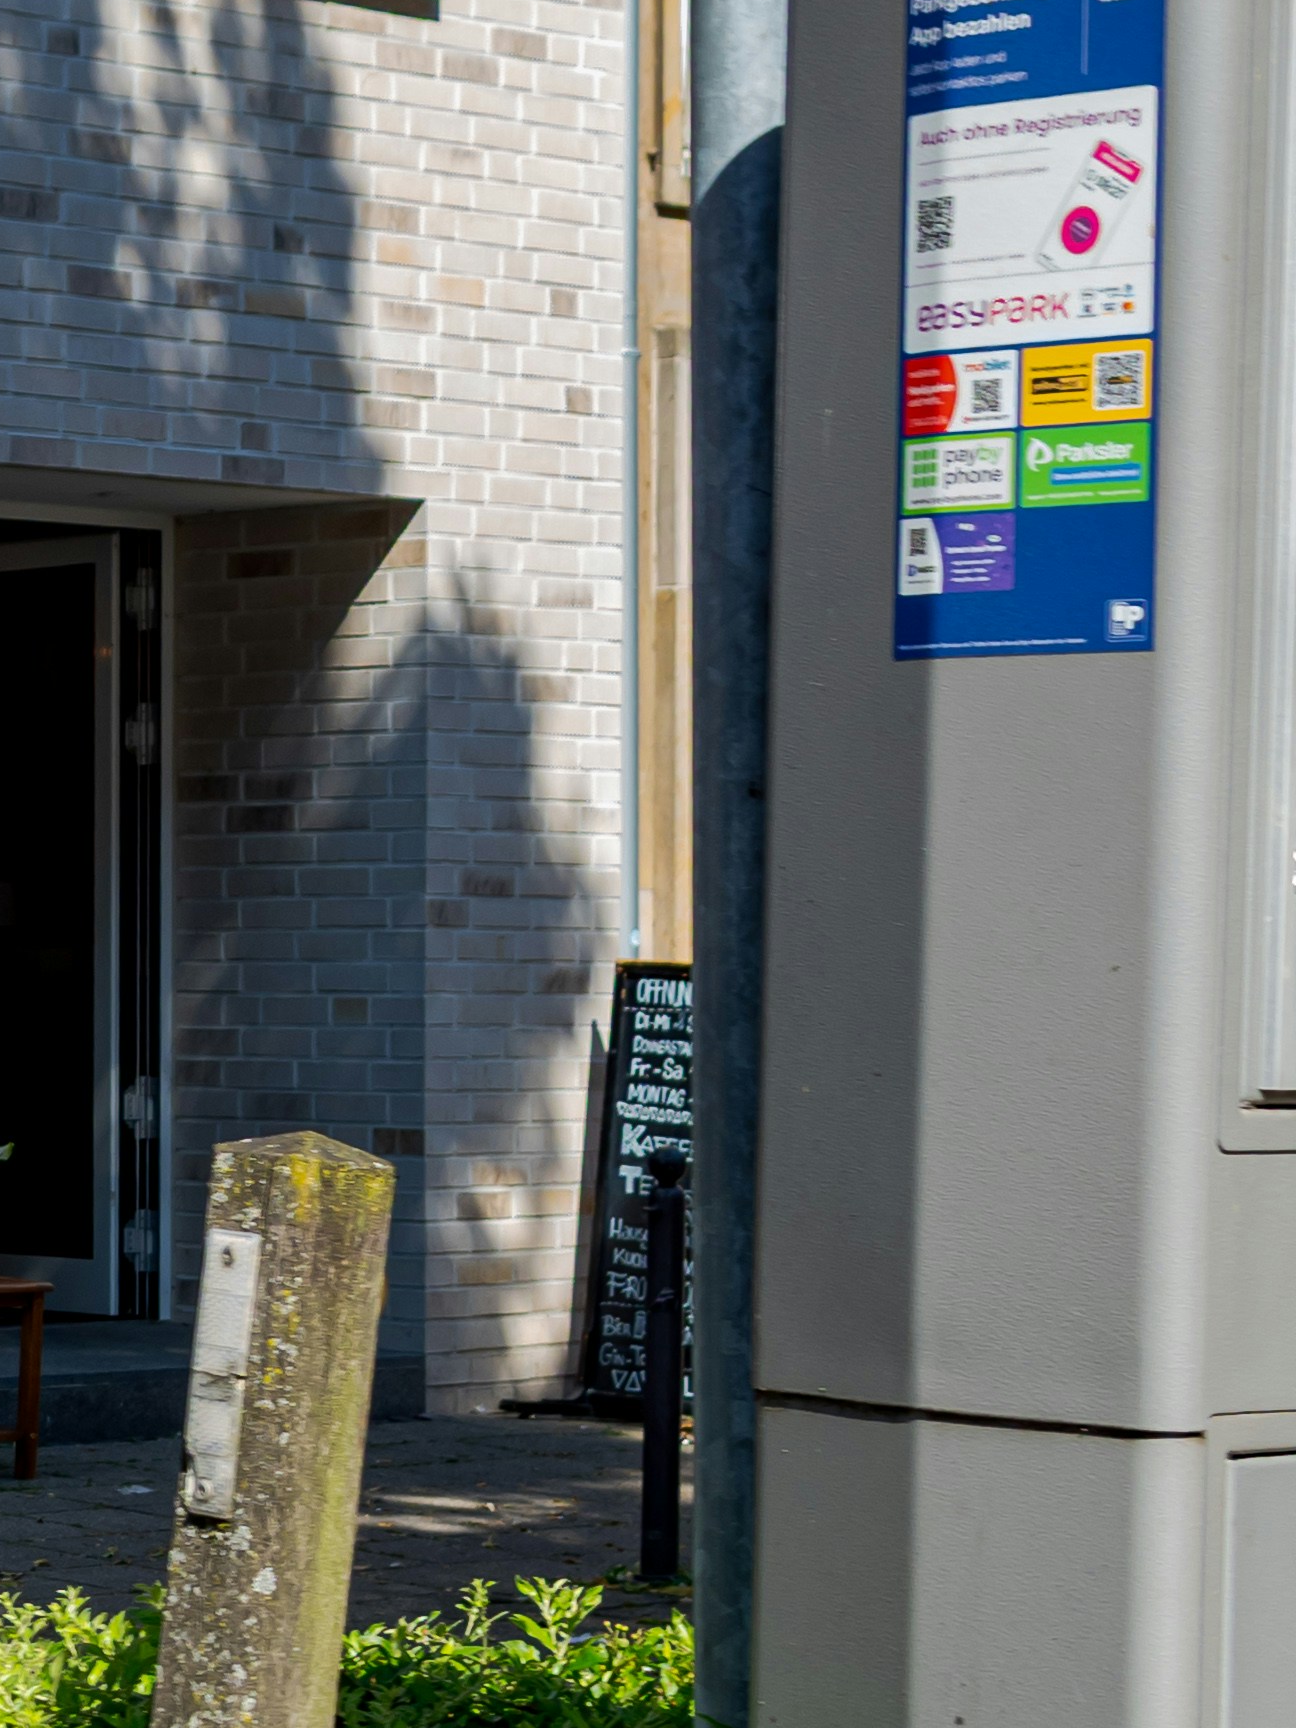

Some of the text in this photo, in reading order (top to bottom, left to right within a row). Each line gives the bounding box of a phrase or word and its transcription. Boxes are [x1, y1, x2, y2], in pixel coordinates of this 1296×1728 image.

[909, 12, 1032, 48] App bezahlen
[919, 108, 1142, 148] Auch ohne Registrierung
[1055, 440, 1135, 462] Parkster
[941, 466, 1004, 490] phone
[631, 1034, 693, 1057] DONNERSTA
[627, 1083, 688, 1108] MONTAG
[618, 1164, 654, 1196] TE
